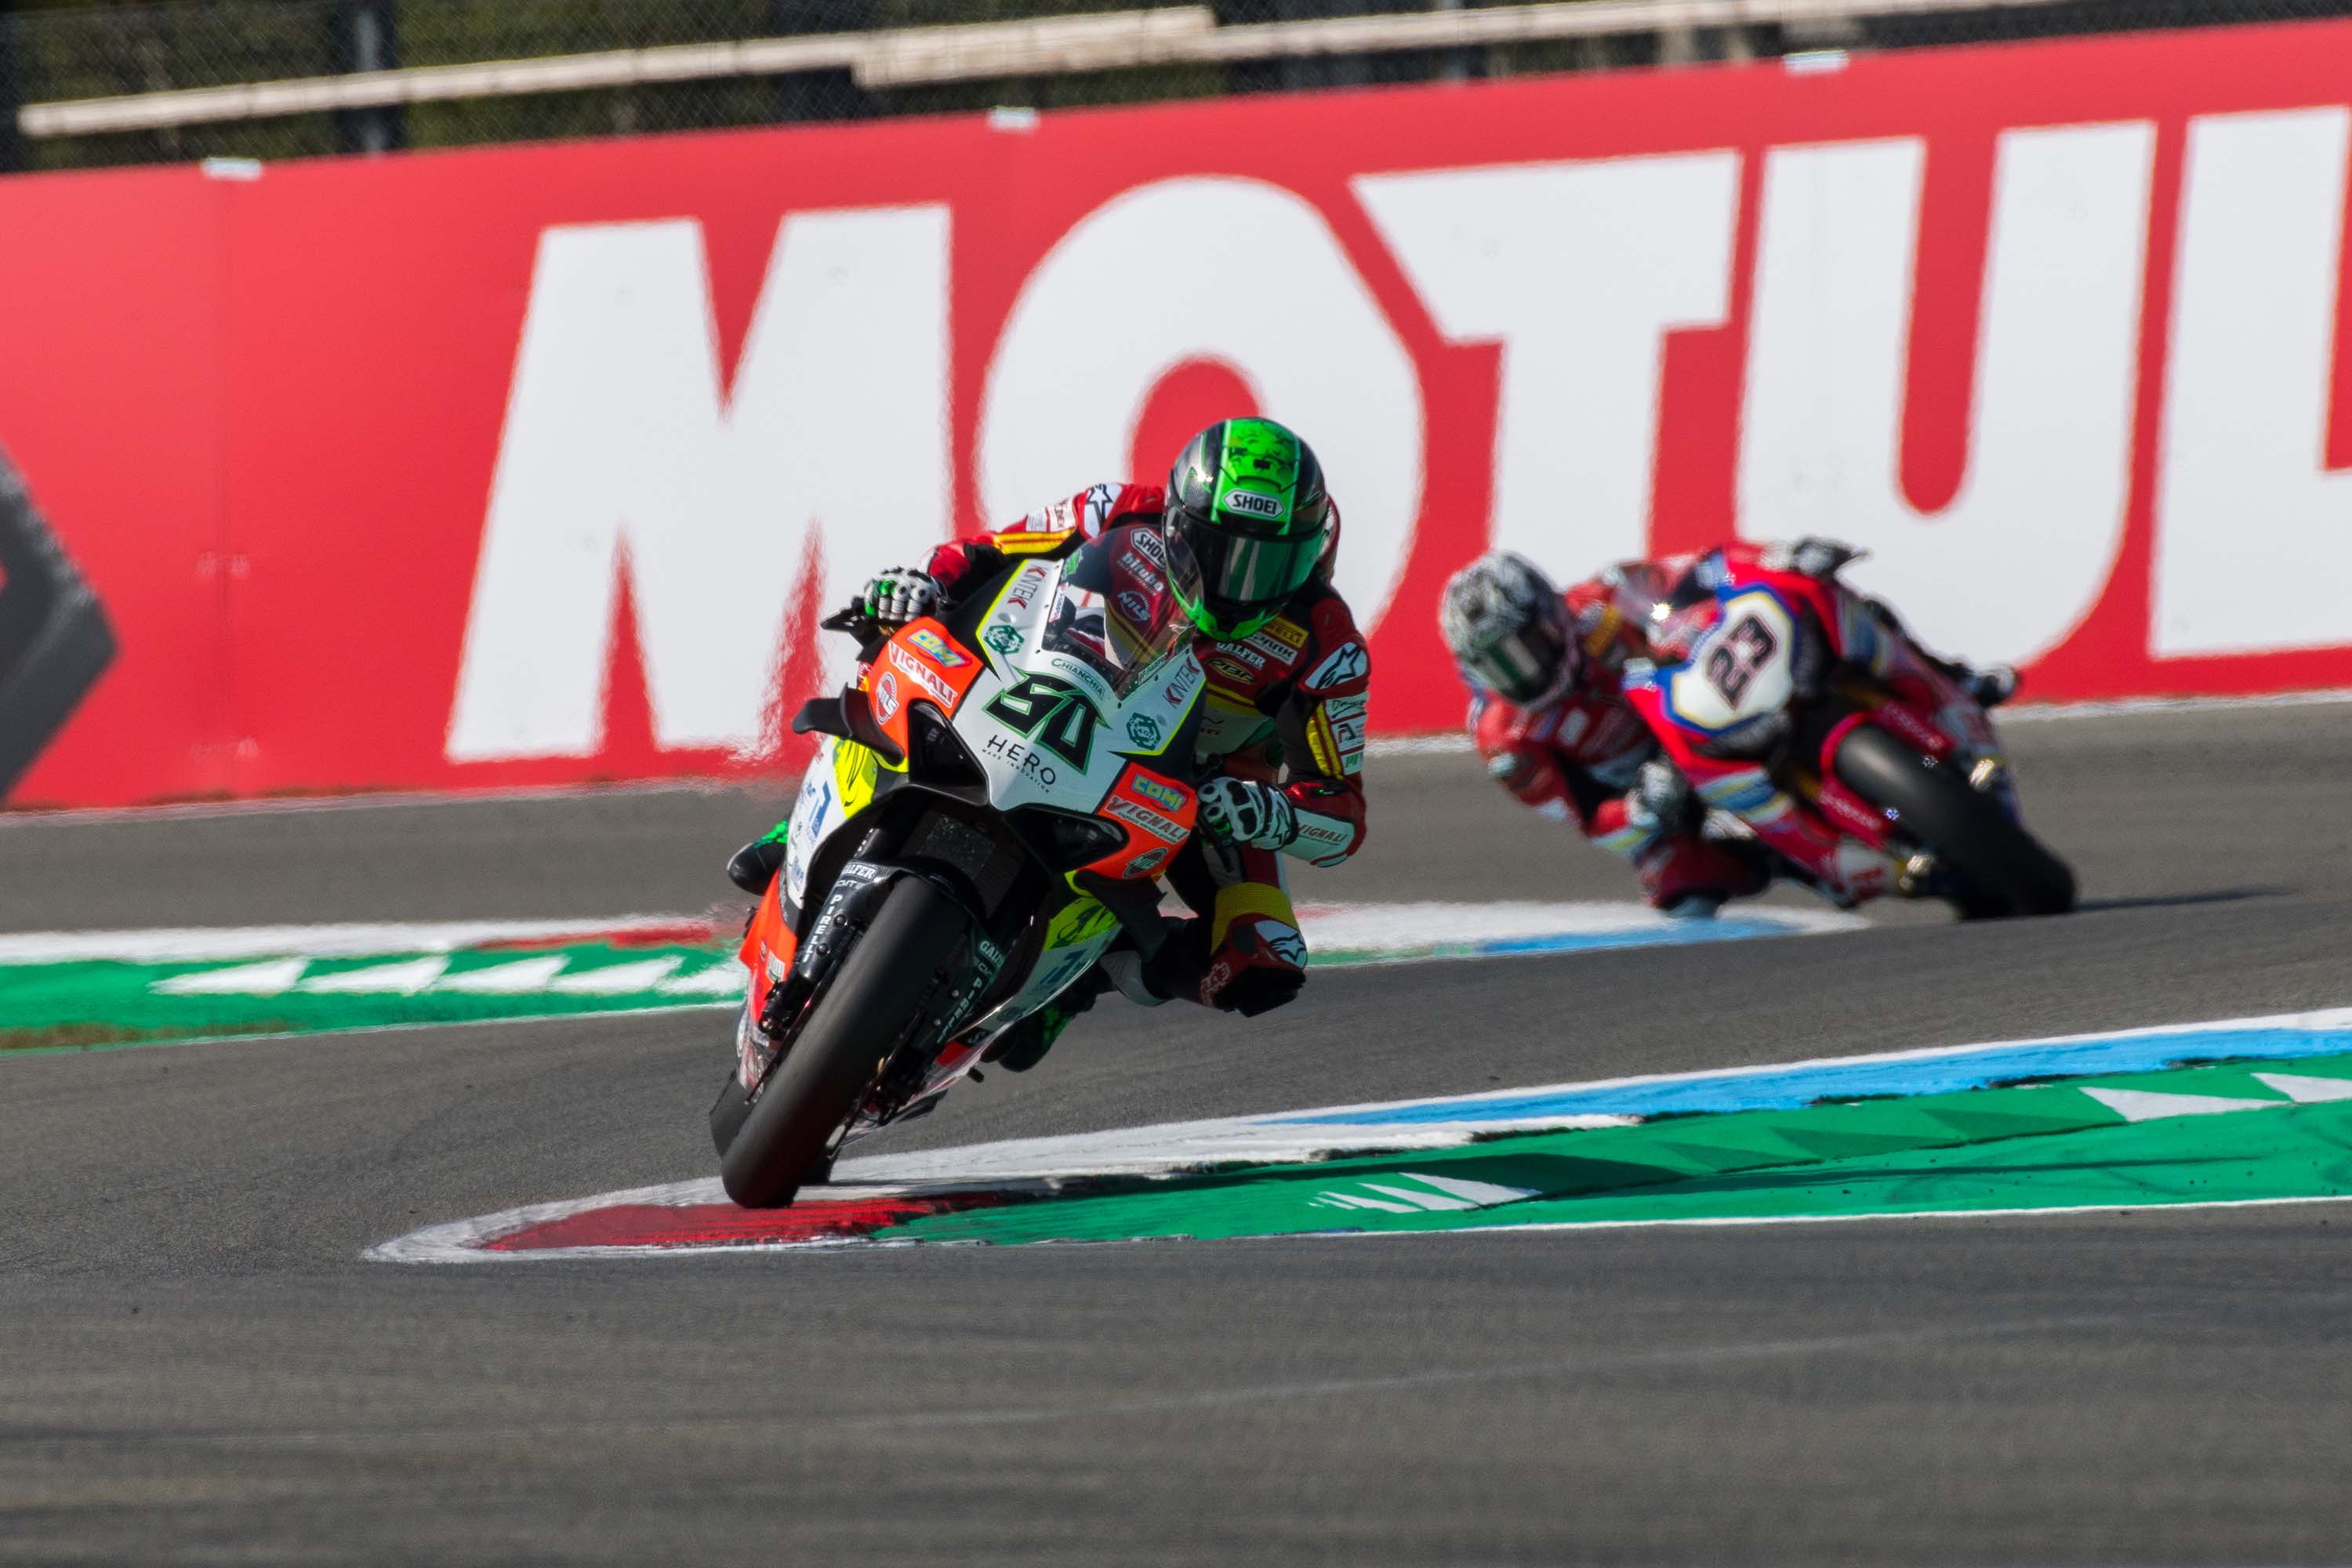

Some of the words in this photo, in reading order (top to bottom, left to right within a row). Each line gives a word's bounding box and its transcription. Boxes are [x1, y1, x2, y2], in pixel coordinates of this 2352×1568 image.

[444, 103, 2352, 764] MOTUL
[1232, 494, 1278, 514] SHOEI
[1136, 533, 1166, 564] SHOE
[890, 641, 954, 704] VIGNALI
[1051, 658, 1104, 697] CHIANCHIA
[1706, 614, 1776, 710] 23
[986, 735, 1056, 786] HERO
[1006, 760, 1050, 794] INNOVATION
[1105, 797, 1189, 840] VIGNALI
[803, 894, 843, 963] PIRELLI
[936, 976, 983, 1045] PIRELLI
